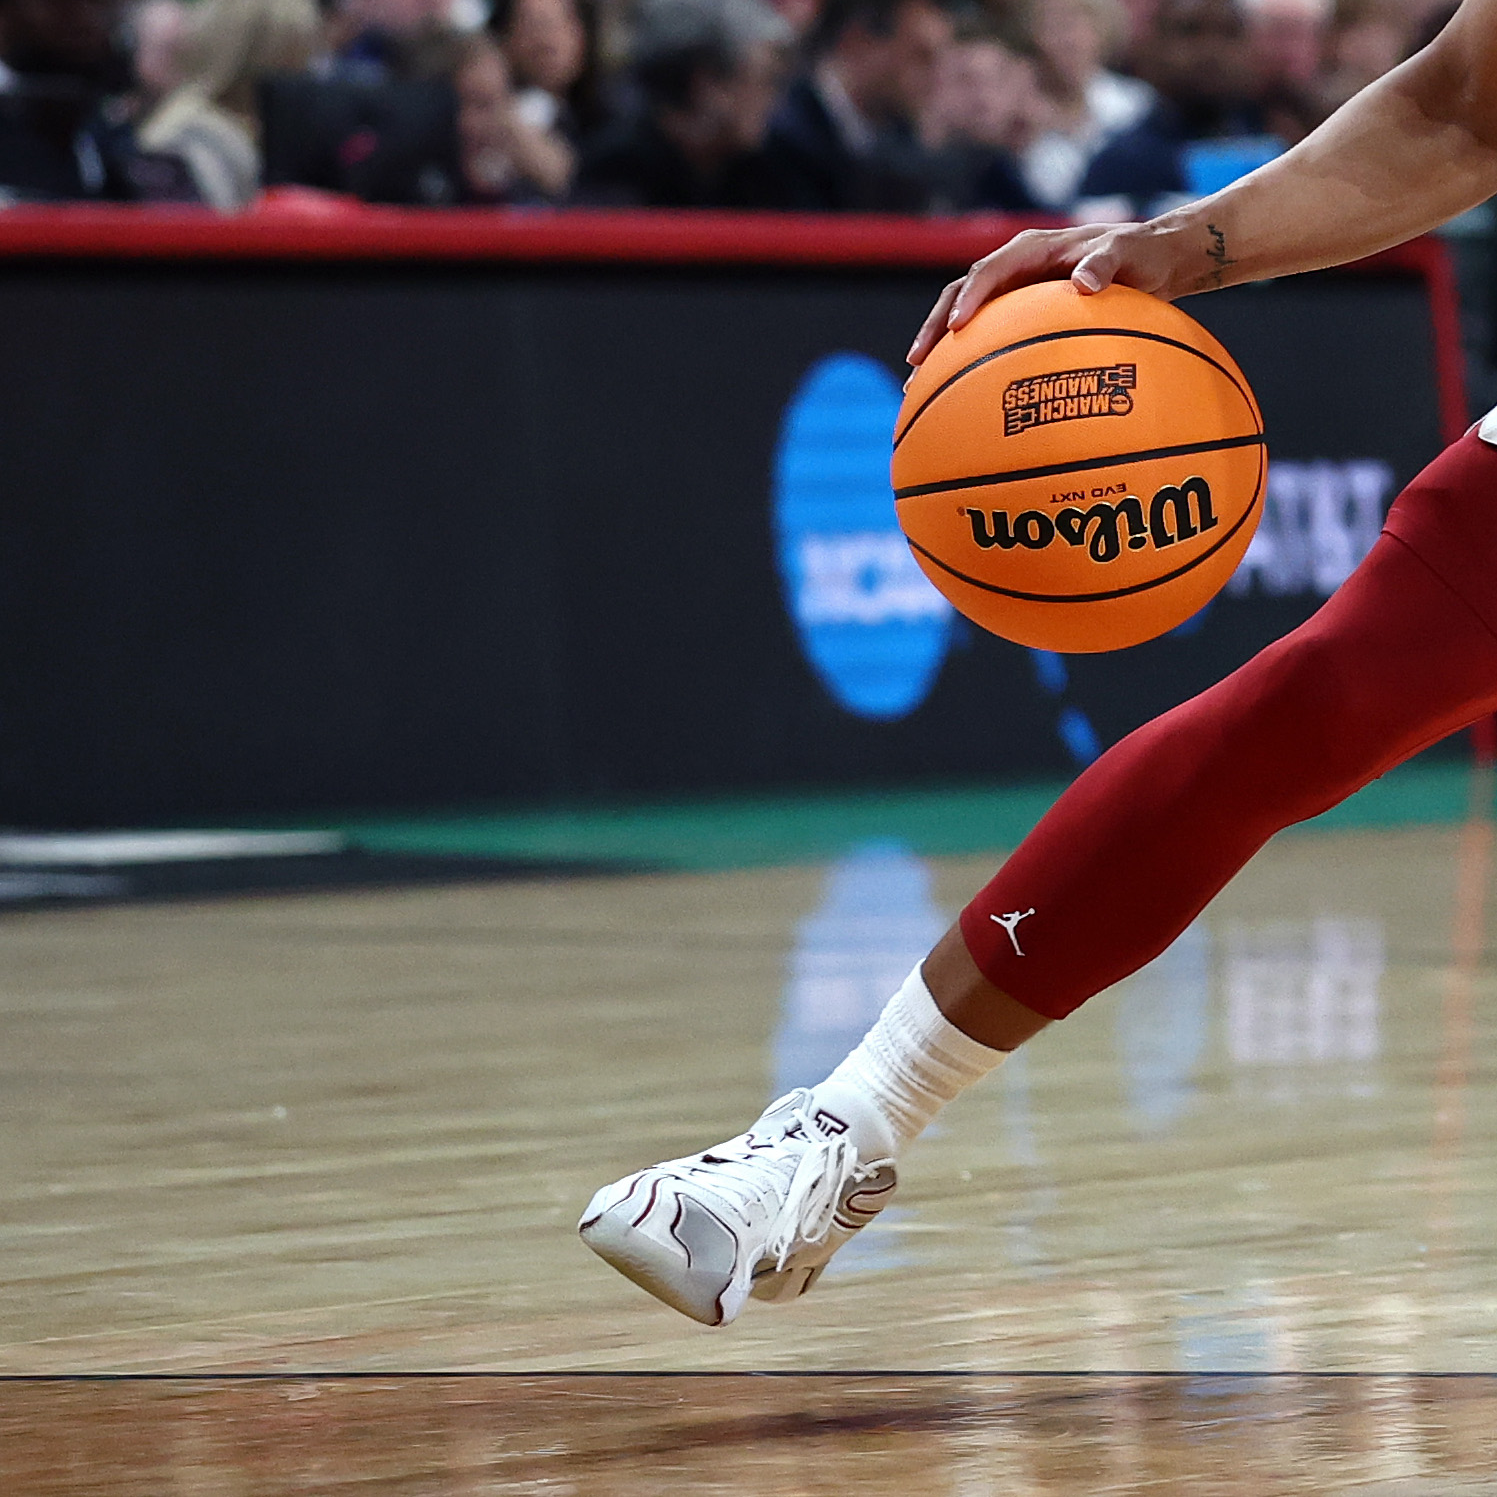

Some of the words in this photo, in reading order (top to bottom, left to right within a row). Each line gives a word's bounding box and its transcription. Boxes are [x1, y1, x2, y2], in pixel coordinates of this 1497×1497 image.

[1004, 375, 1098, 409] MADNESS
[1039, 394, 1110, 422] MARCH
[1050, 490, 1085, 504] NXT
[1091, 483, 1127, 498] EVO
[967, 476, 1218, 564] Wilson
